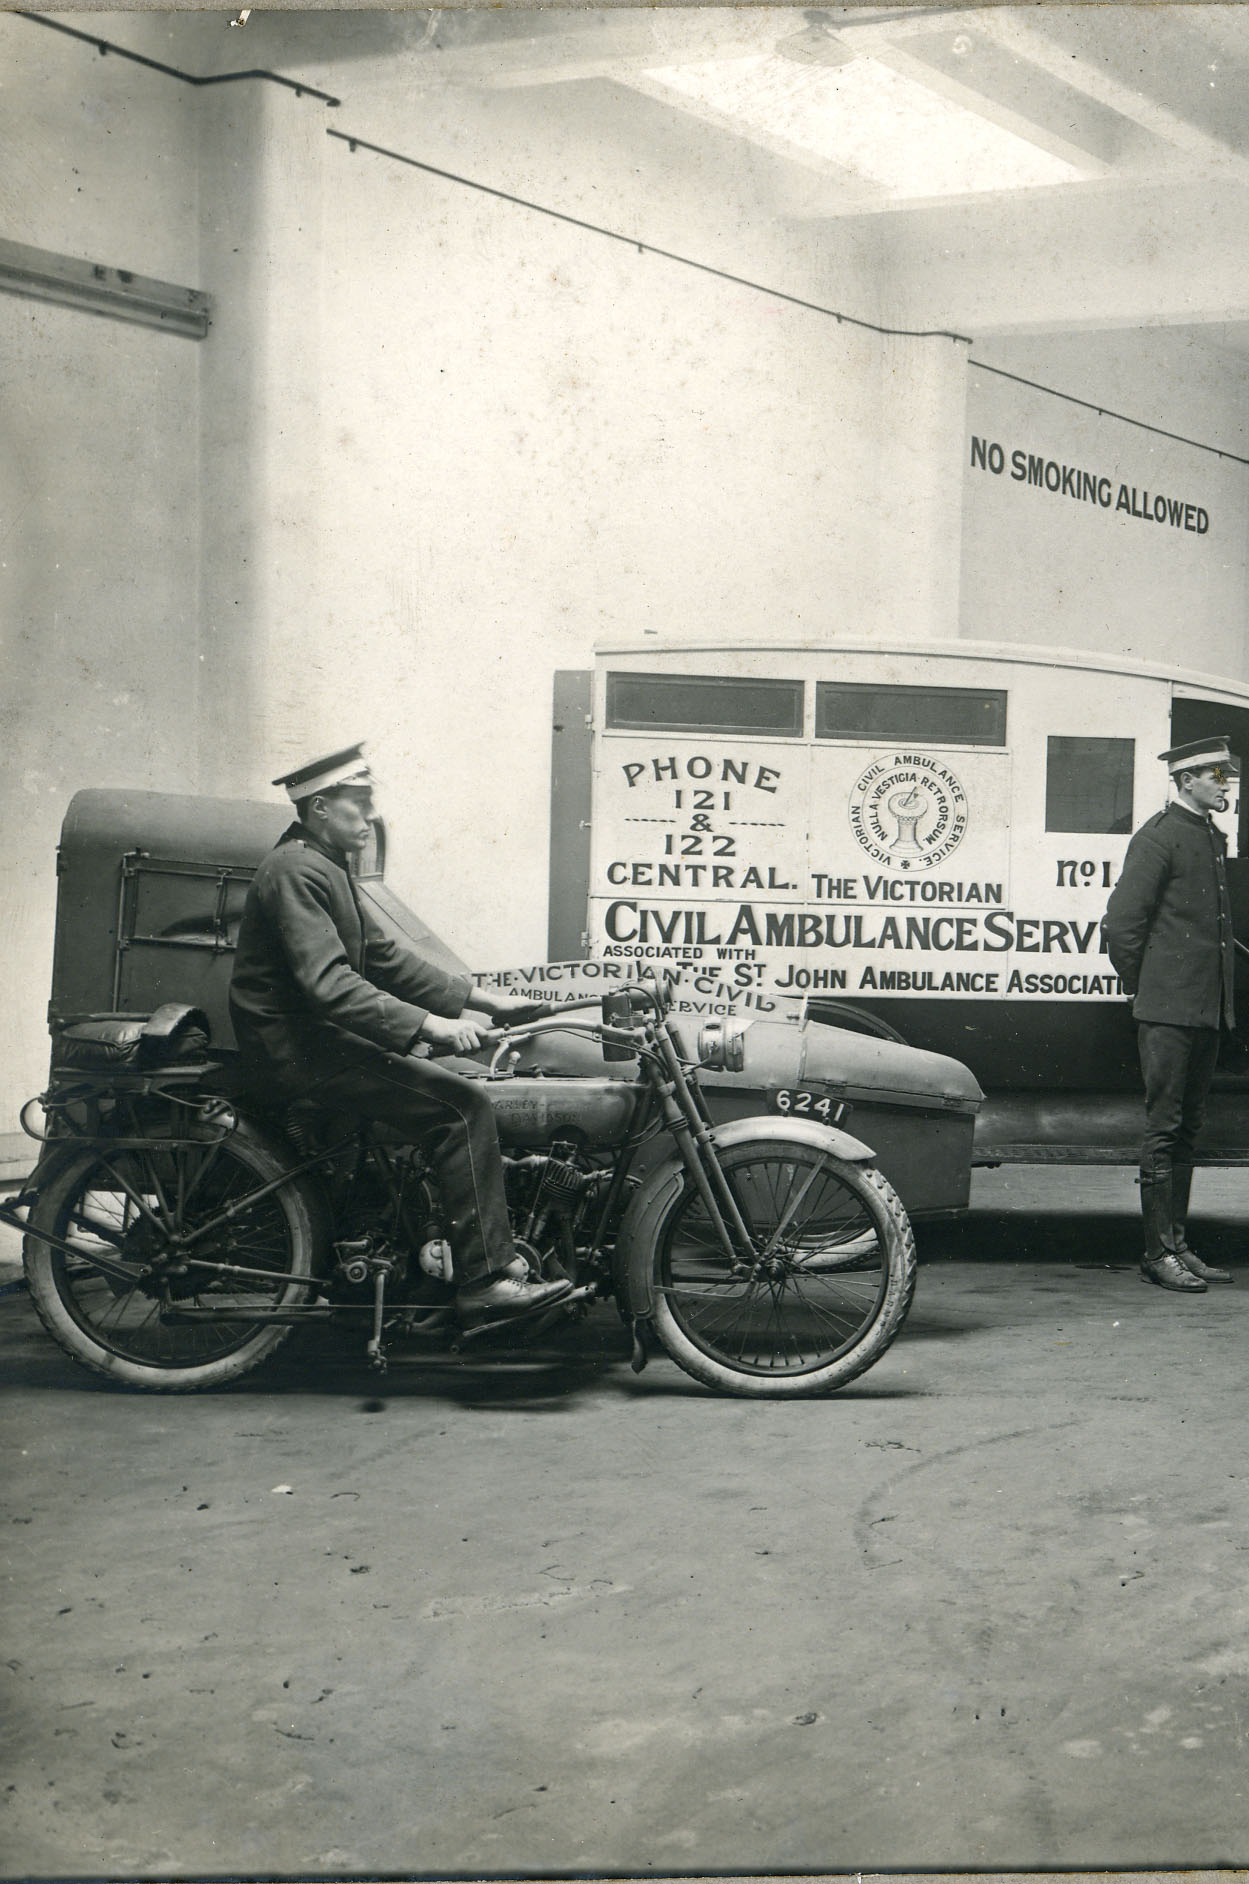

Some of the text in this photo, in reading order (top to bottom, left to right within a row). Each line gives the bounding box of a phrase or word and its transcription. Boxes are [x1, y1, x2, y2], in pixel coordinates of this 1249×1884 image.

[971, 436, 1209, 534] NO SMOKING ALLOWED
[622, 756, 781, 794] PHONE
[675, 790, 731, 810] 121
[851, 755, 966, 866] VICTORIAN CIVIL AMBULANCE SERVICE.
[690, 813, 714, 832] &
[869, 804, 888, 841] NULLA
[665, 834, 736, 857] 122
[607, 862, 798, 889] CENTRAL.
[811, 874, 1002, 903] THE VICTORIAN
[603, 901, 1109, 954] CIVIL AMBULANCE SERVI
[603, 945, 755, 961] ASSOCIATED WITH
[472, 962, 776, 1012] THE VICTORIAN CIVIL
[774, 964, 846, 989] JOHN
[859, 966, 999, 993] AMBULANCE
[1006, 969, 1132, 996] ASSOCIATI
[668, 1001, 737, 1016] ERVICE
[776, 1090, 844, 1121] 6241
